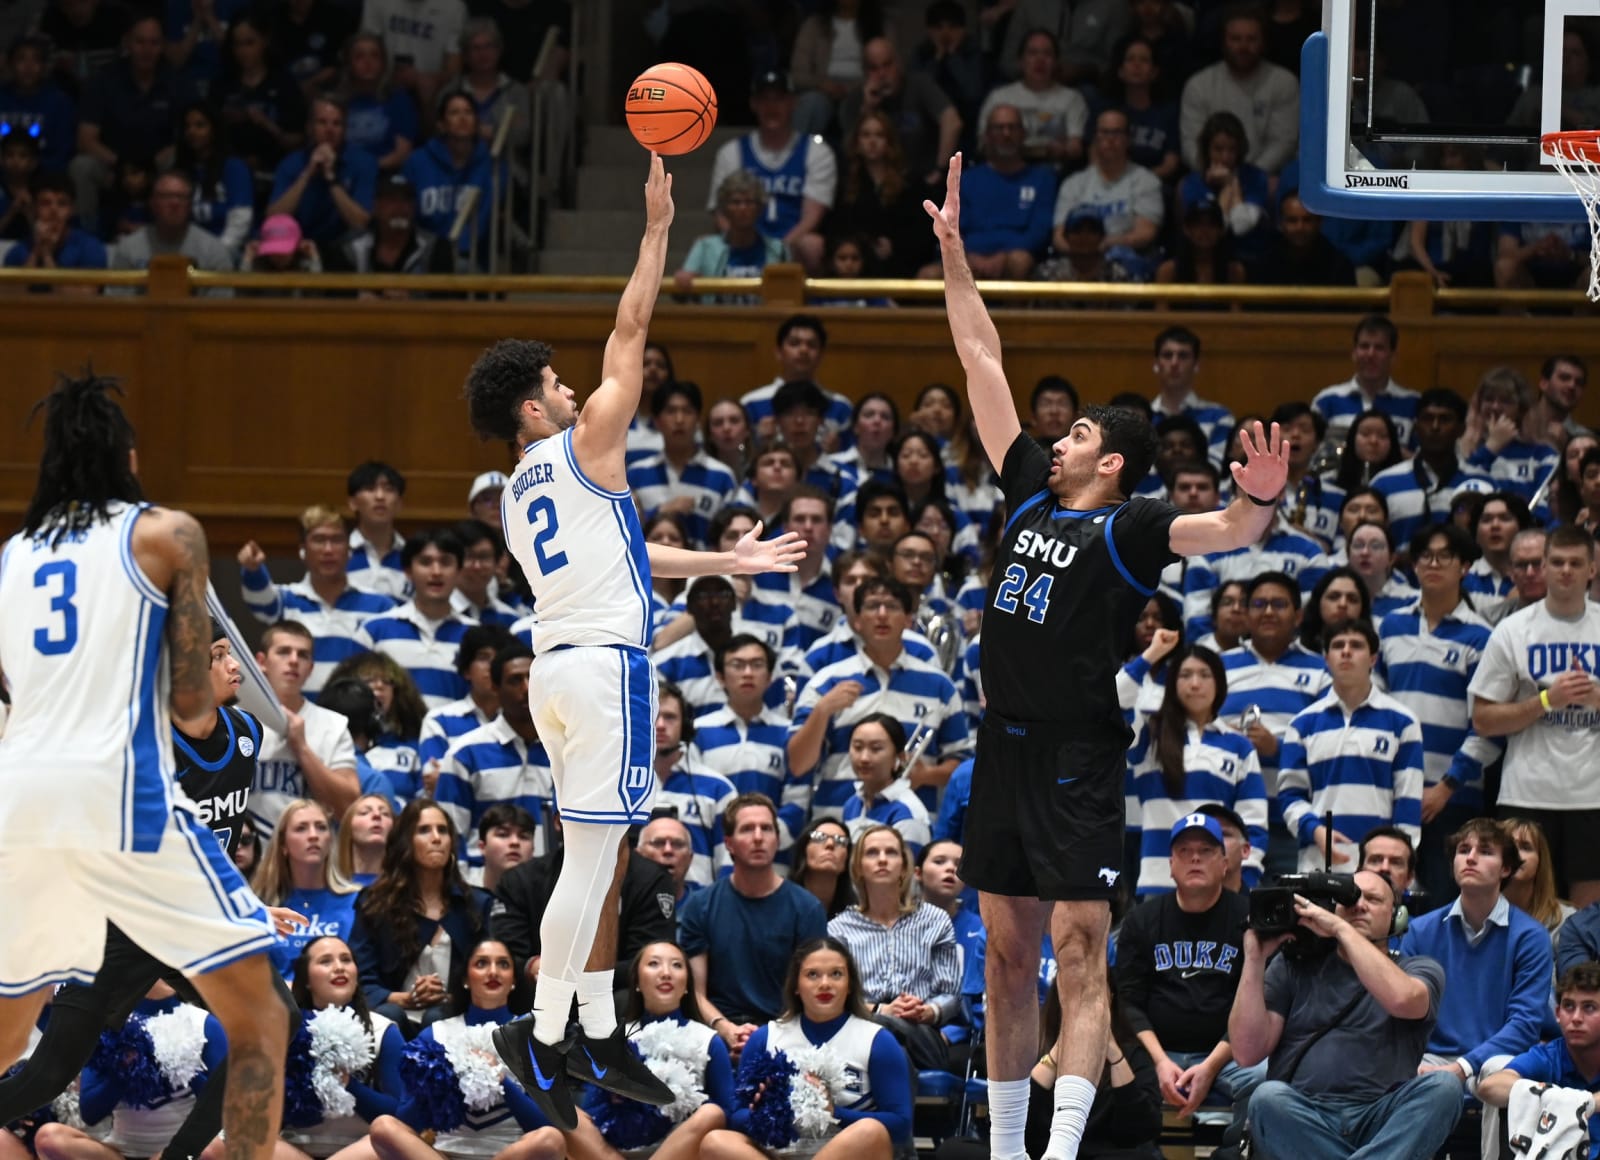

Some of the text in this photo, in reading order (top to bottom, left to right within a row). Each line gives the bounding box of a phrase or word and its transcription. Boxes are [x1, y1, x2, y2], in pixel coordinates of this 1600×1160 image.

[1344, 174, 1409, 189] SPALDING
[511, 462, 555, 502] BOOZER
[526, 495, 569, 577] 2
[1013, 529, 1079, 568] SMU
[33, 559, 78, 656] 3
[993, 562, 1055, 624] 24
[1006, 726, 1026, 736] SMU
[251, 760, 305, 797] UK
[626, 766, 649, 788] D
[197, 787, 250, 825] SMU
[286, 914, 339, 937] uke
[1153, 941, 1239, 974] DUKE
